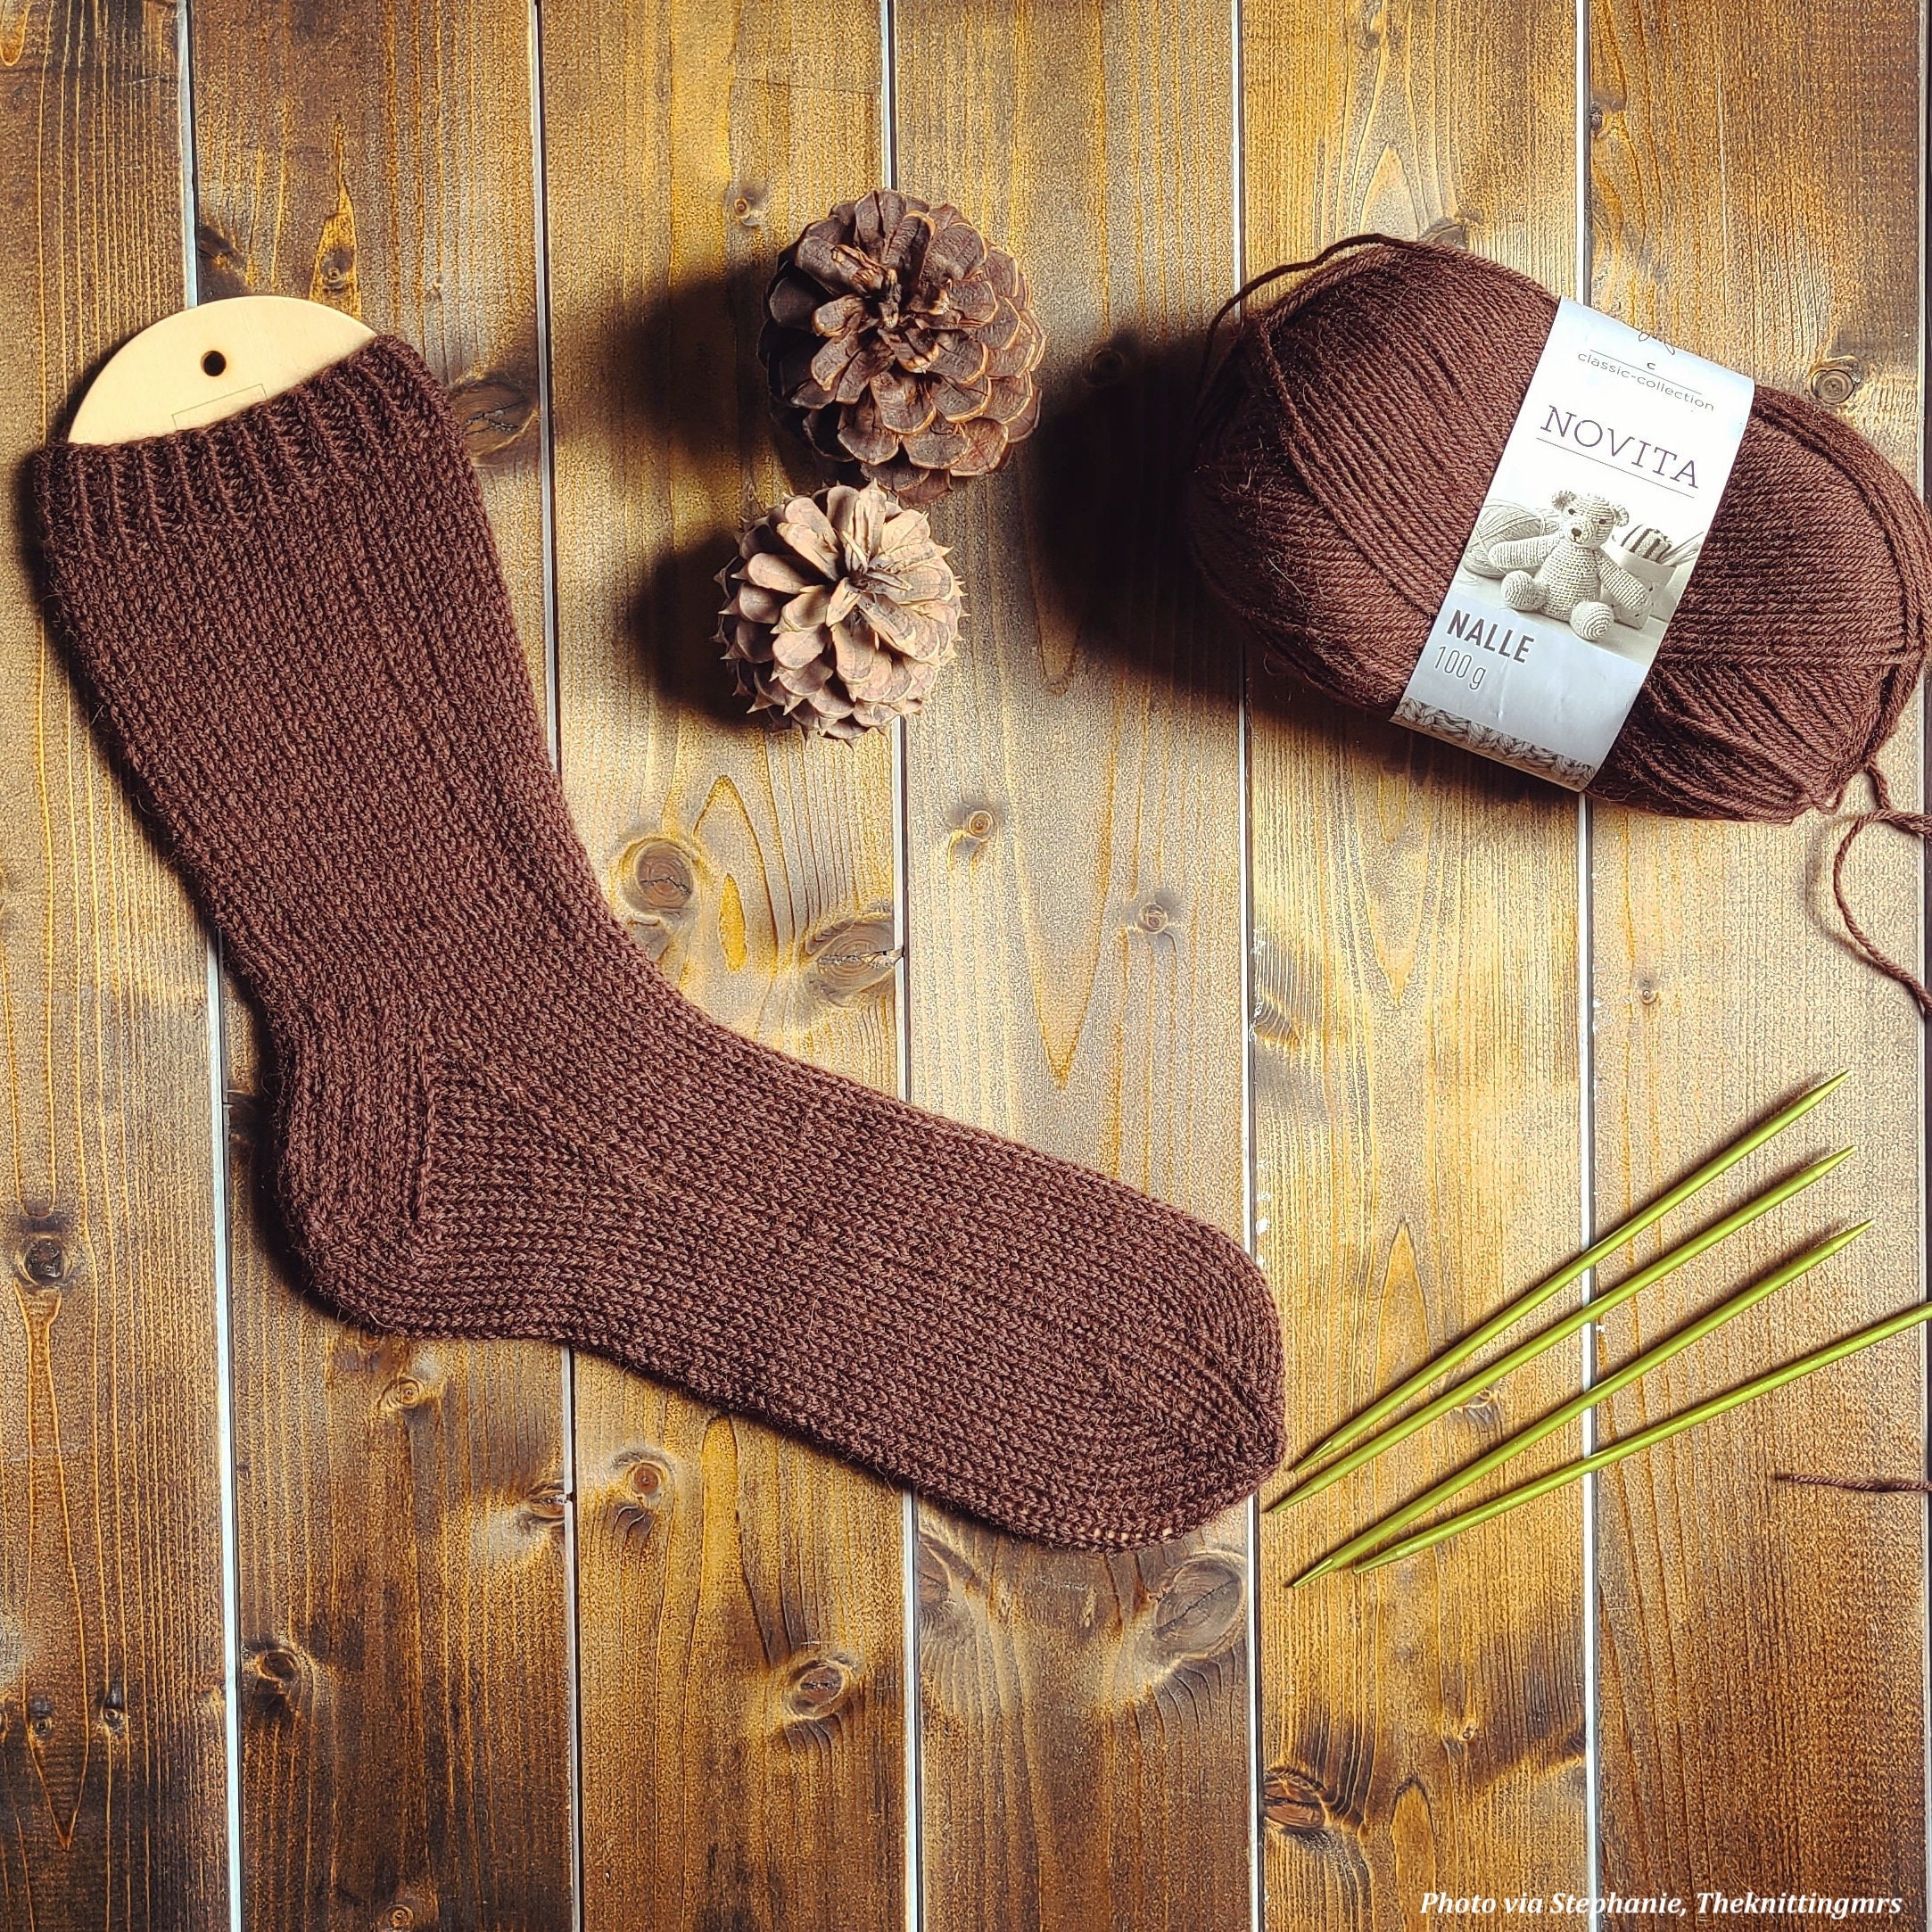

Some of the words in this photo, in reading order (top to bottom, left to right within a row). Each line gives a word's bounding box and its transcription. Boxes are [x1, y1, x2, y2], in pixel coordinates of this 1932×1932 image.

[1577, 352, 1715, 412] classic-collection
[1540, 405, 1699, 489] NOVITA
[1446, 608, 1535, 664] NALLE
[1433, 645, 1473, 679] 100
[1469, 665, 1488, 691] g
